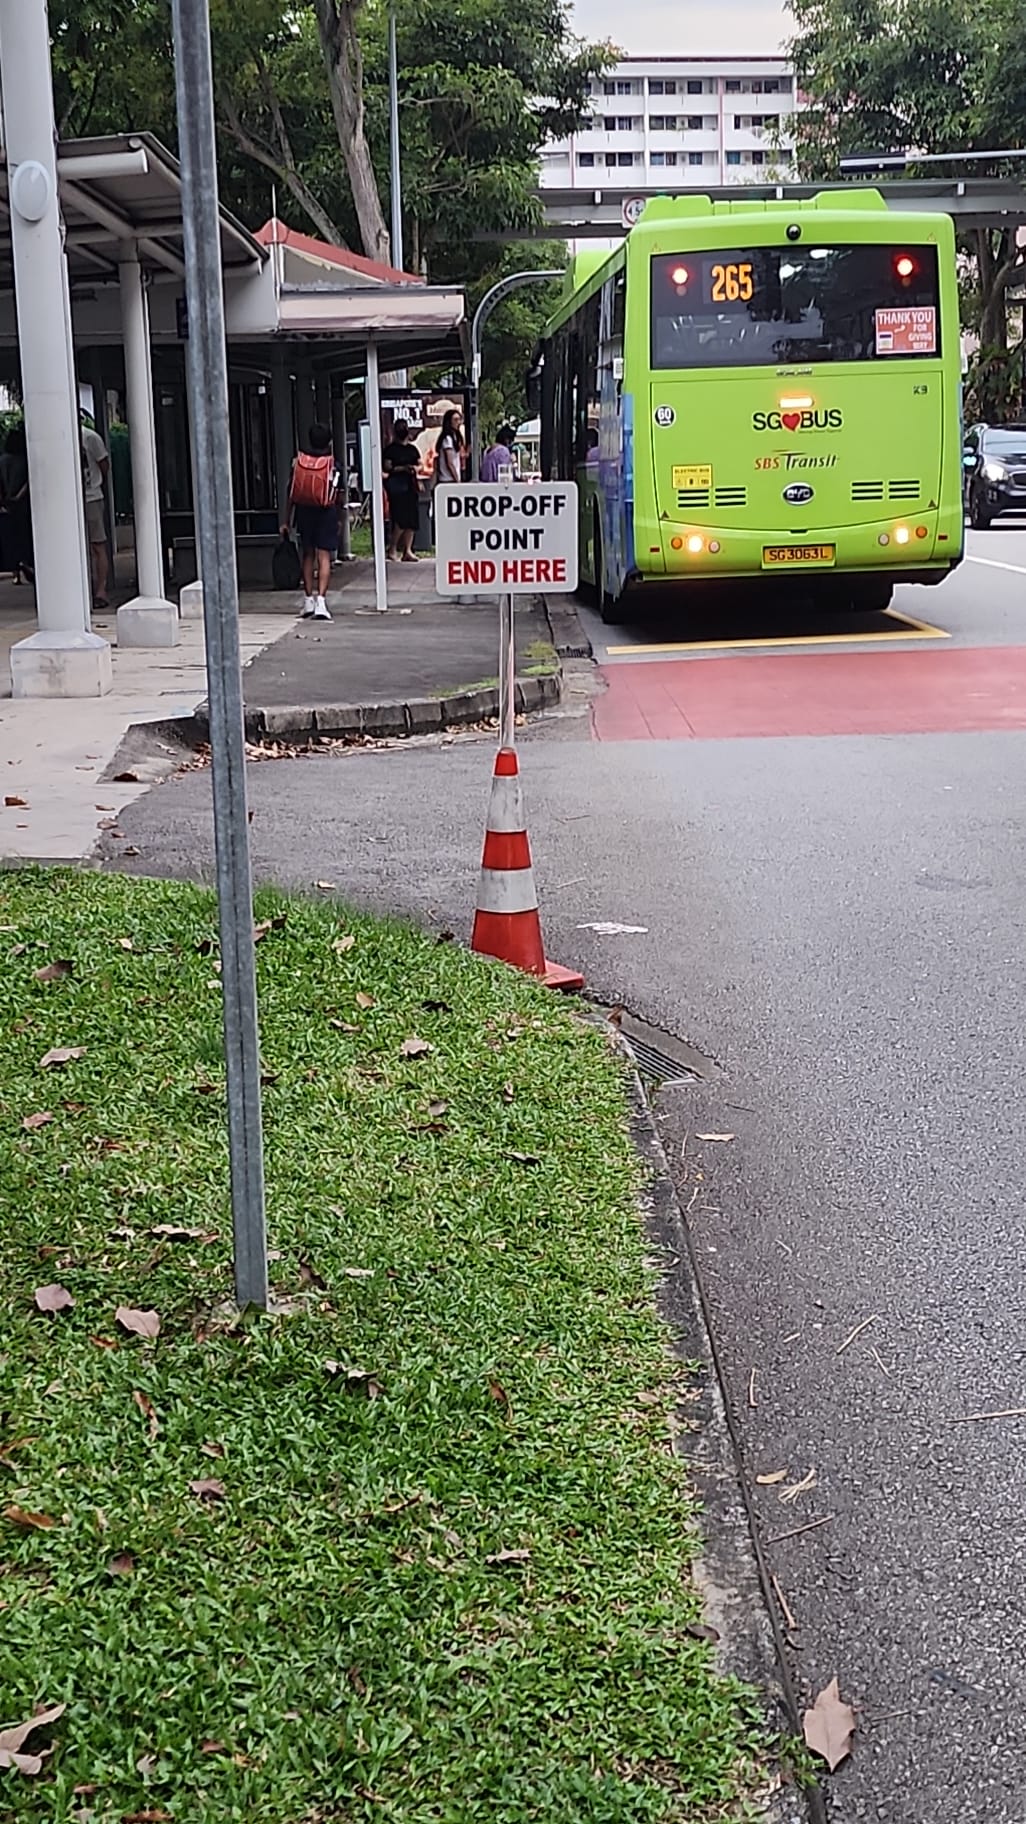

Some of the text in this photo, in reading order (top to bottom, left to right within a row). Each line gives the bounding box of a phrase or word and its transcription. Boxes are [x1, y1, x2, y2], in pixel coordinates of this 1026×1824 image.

[711, 264, 753, 301] 265
[878, 311, 932, 325] THANK YOU
[913, 323, 928, 332] FOR
[908, 332, 933, 342] GIVING
[657, 407, 672, 420] 60
[800, 409, 843, 429] BUS
[754, 452, 837, 471] SBS Transit
[447, 495, 566, 518] DROP-OFF
[470, 529, 544, 551] POINT
[768, 547, 828, 561] SG3063L
[448, 559, 566, 585] END HERE
